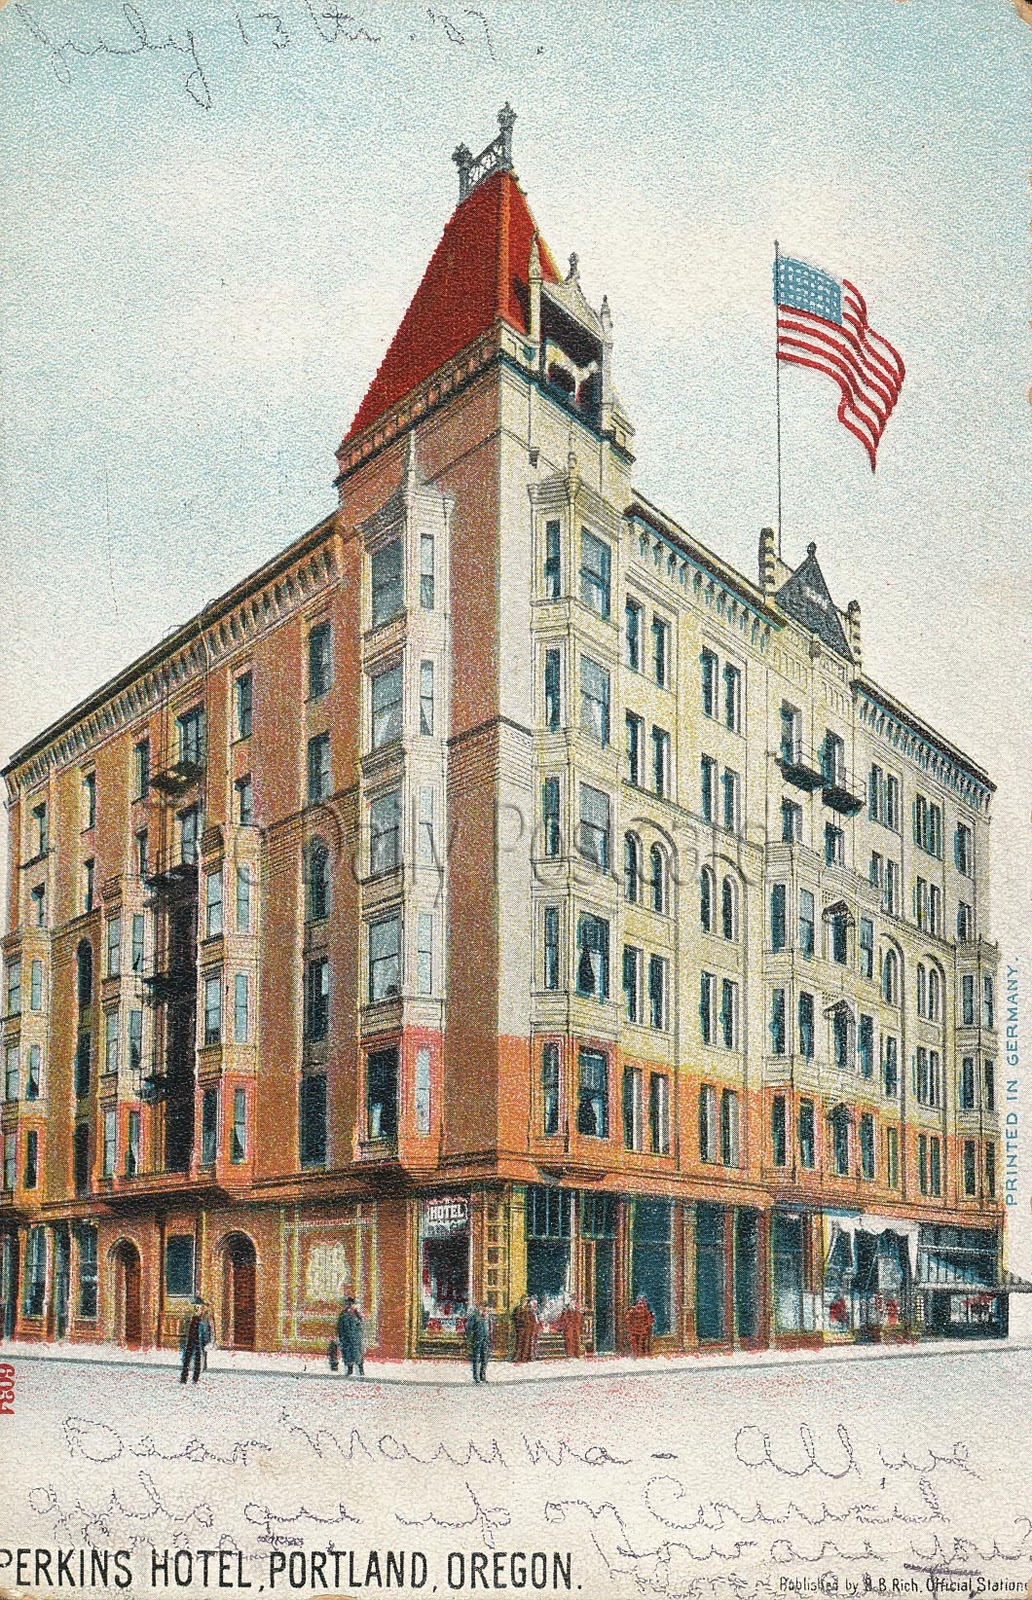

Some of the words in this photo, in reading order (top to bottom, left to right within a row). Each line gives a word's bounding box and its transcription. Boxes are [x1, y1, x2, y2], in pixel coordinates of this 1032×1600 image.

[1006, 1079, 1018, 1102] IN
[1005, 1111, 1019, 1206] PRINTED
[429, 1203, 466, 1220] HOTEL
[0, 1548, 132, 1589] PERKINS
[447, 1551, 583, 1592] OREGON.
[845, 1578, 859, 1596] by
